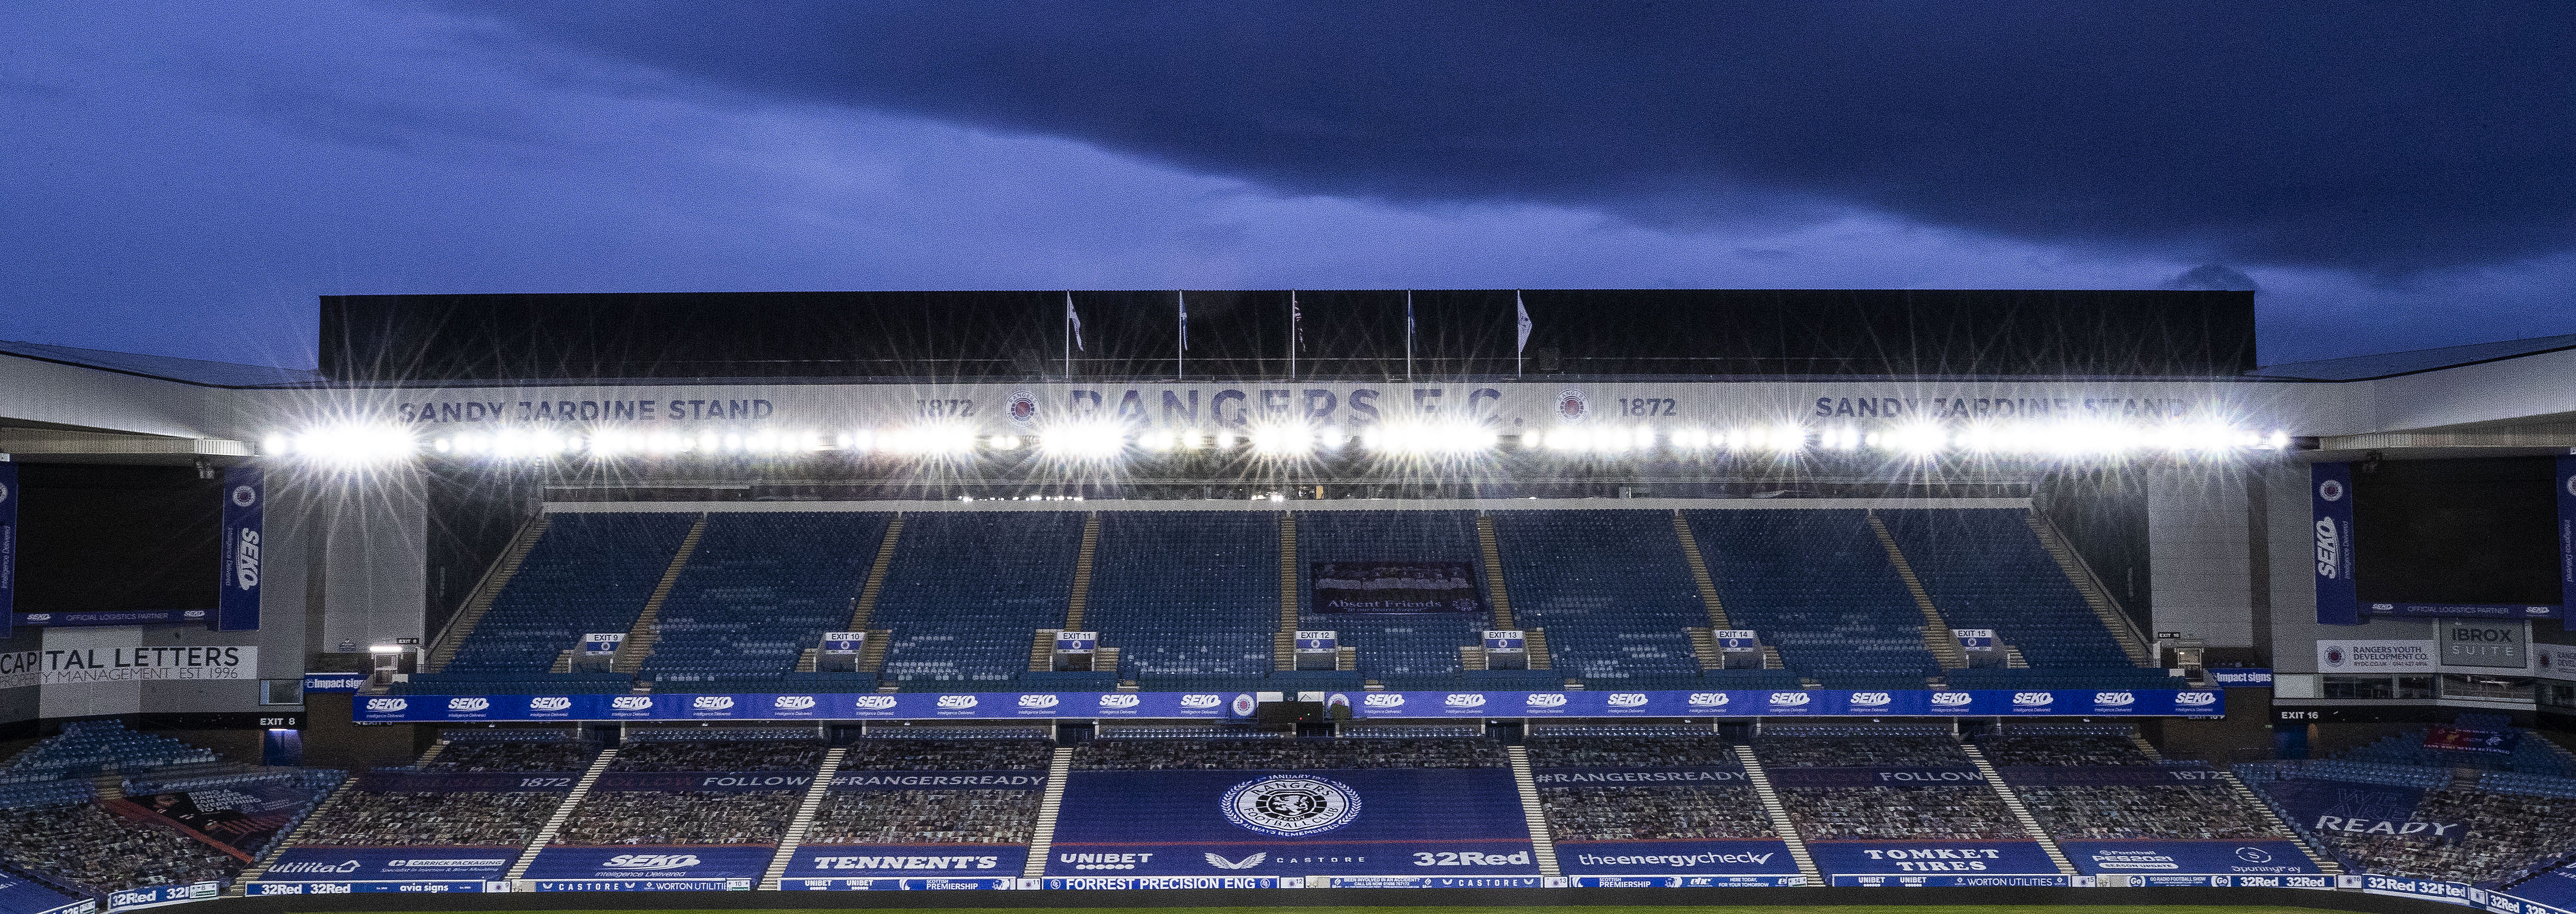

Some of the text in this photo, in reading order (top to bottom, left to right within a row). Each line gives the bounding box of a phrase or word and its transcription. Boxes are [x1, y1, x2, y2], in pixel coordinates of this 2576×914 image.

[399, 399, 773, 422] SANDY JARDINE STAND
[916, 399, 974, 418] 1872
[1070, 388, 1523, 426] RANGERS FC.
[1619, 398, 1676, 417] 1872
[1816, 397, 1917, 418] SANDY
[1933, 398, 2069, 418] JARDINE
[2315, 516, 2336, 579] SEKO
[241, 527, 259, 590] SEKO
[1328, 599, 1441, 608] Absent Friends
[2452, 628, 2512, 642] IBROX
[2452, 645, 2514, 656] SUITE
[0, 647, 239, 674] CAPITAL LETTERS
[58, 667, 170, 683] MANAGEMENT
[180, 667, 203, 679] EST
[210, 667, 238, 679] 1996
[2217, 672, 2271, 682] Impact signs
[314, 679, 345, 689] Impact
[367, 698, 407, 711] SEKO
[449, 698, 489, 710] SEKO
[530, 697, 571, 710] SEKO
[612, 697, 653, 710] SEKO
[693, 696, 734, 710] SEKO
[774, 696, 816, 709] SEKO
[856, 696, 897, 709] SEKO
[937, 695, 978, 709] SEKO
[1018, 694, 1059, 708] SEKO
[1099, 694, 1140, 708] SEKO
[1180, 694, 1222, 708] SEKO
[1364, 694, 1405, 708] SEKO
[1445, 694, 1486, 707] SEKO
[1526, 693, 1567, 707] SEKO
[1608, 693, 1649, 707] SEKO
[1688, 693, 1729, 706] SEKO
[1770, 692, 1810, 706] SEKO
[1851, 692, 1891, 705] SEKO
[1931, 692, 1972, 706] SEKO
[2013, 692, 2053, 705] SEKO
[2094, 693, 2134, 705] SEKO
[2175, 692, 2215, 705] SEKO
[703, 776, 811, 786] FOLLOW
[830, 776, 1046, 786] #RANGERSREADY
[1536, 771, 1746, 783] #RANGERSREADY
[1879, 772, 1983, 781] FOLLOW
[2169, 771, 2225, 780] 1872
[520, 778, 571, 787] 1872
[1251, 782, 1334, 797] RANGERS
[1243, 807, 1339, 828] FOOTBALL CLUB
[1243, 823, 1339, 837] ALWAYS REMEMBERED
[2315, 815, 2458, 836] READY
[602, 854, 701, 867] SEKO
[1060, 853, 1153, 863] UNIBET
[1413, 850, 1530, 866] 32Red
[1578, 851, 1762, 866] theenergycheck
[1863, 849, 2000, 859] TOMKET
[268, 860, 336, 873] utilita
[813, 856, 998, 869] TENNENT'S
[1895, 861, 1987, 871] TIRES
[309, 883, 351, 894] 32Red
[400, 883, 449, 893] avia signs
[1066, 878, 1256, 890] FORREST PRECISION ENG
[1967, 878, 2053, 886] WORTON UTILITIES
[2240, 877, 2279, 887] 32Red
[2286, 877, 2325, 887] 32Red
[2367, 877, 2416, 892] 32Red
[261, 883, 302, 895] 32Red
[112, 890, 157, 906] 32Red
[2490, 895, 2520, 913] 32Red
